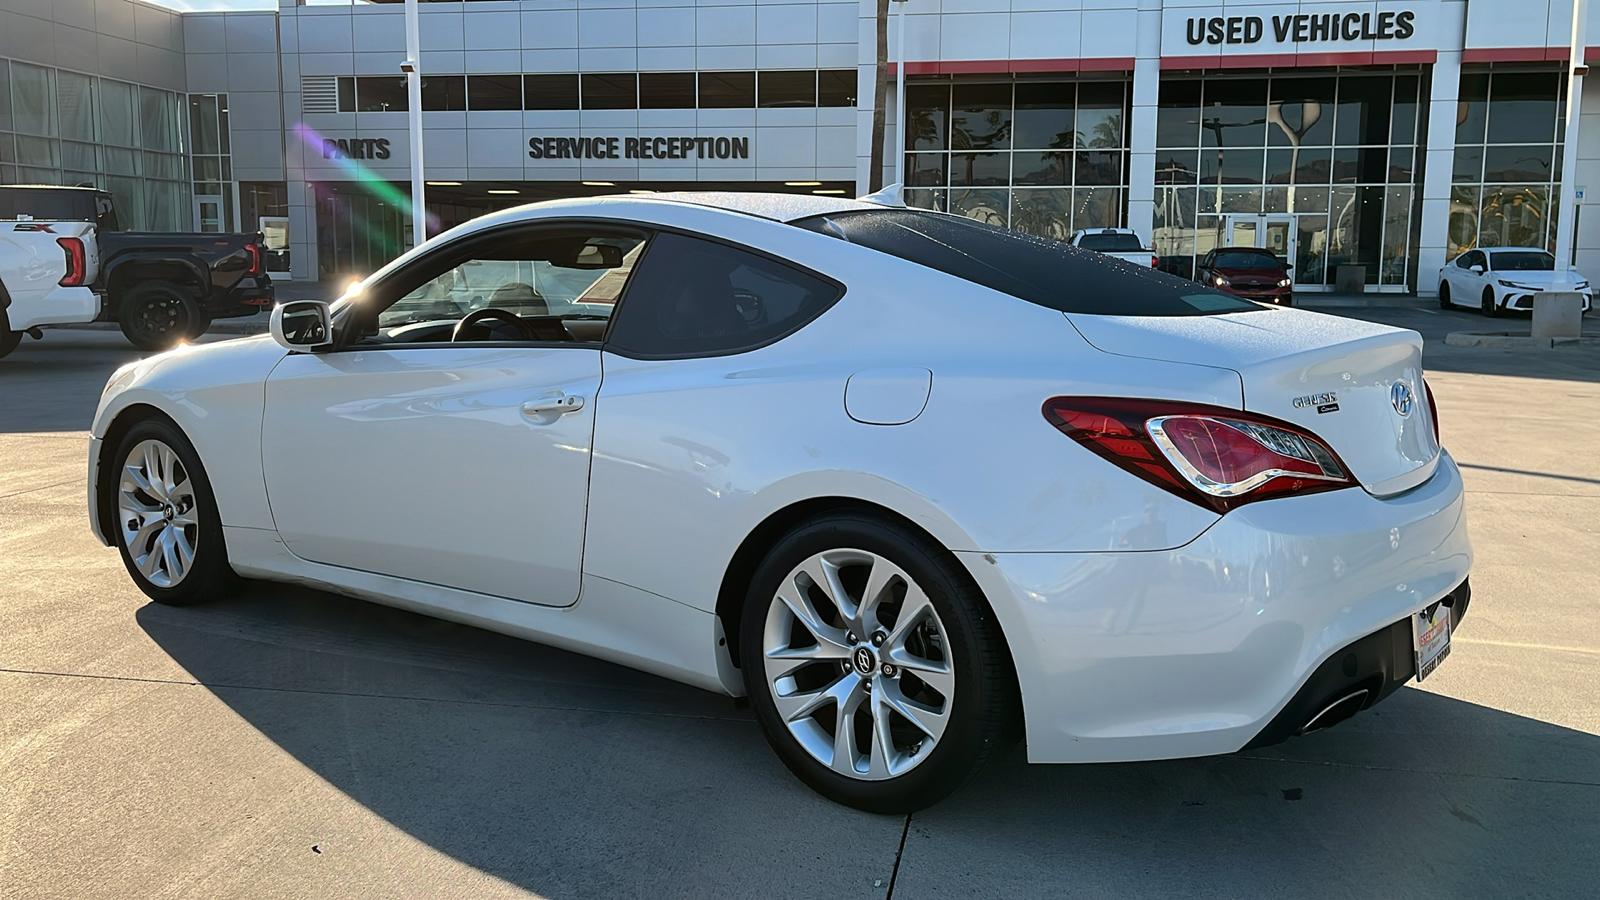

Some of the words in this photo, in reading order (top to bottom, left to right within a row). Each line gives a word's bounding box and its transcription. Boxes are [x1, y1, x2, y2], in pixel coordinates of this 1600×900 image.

[1186, 17, 1263, 45] USED
[1272, 11, 1415, 42] VEHICLES
[323, 138, 391, 160] PARTS
[528, 137, 620, 160] SERVICE
[624, 136, 749, 160] RECEPTION
[1293, 392, 1337, 409] GENESIS
